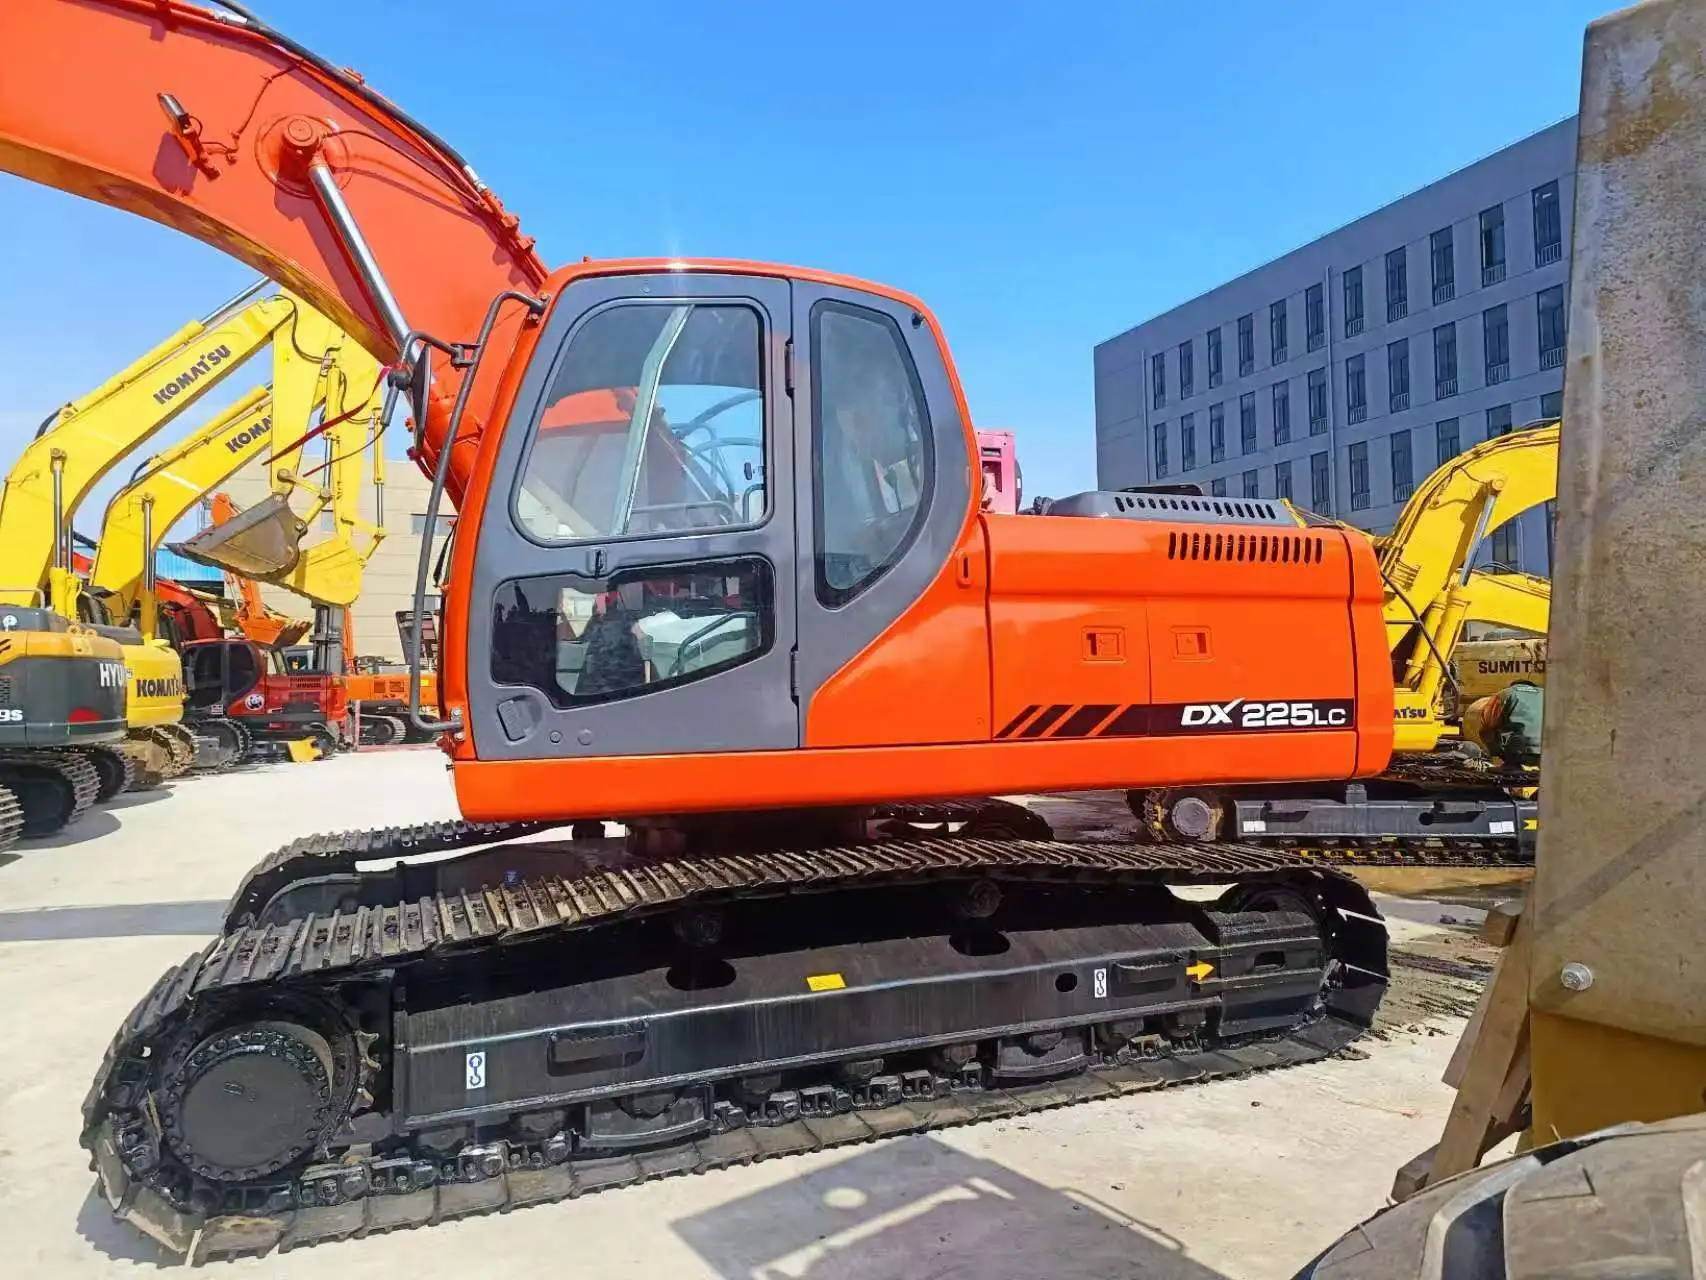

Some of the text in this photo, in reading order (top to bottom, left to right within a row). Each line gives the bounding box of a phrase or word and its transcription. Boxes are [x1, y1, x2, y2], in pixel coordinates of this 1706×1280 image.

[153, 344, 231, 405] KOMATSU
[225, 415, 271, 453] KOMA
[1181, 697, 1246, 726] DX
